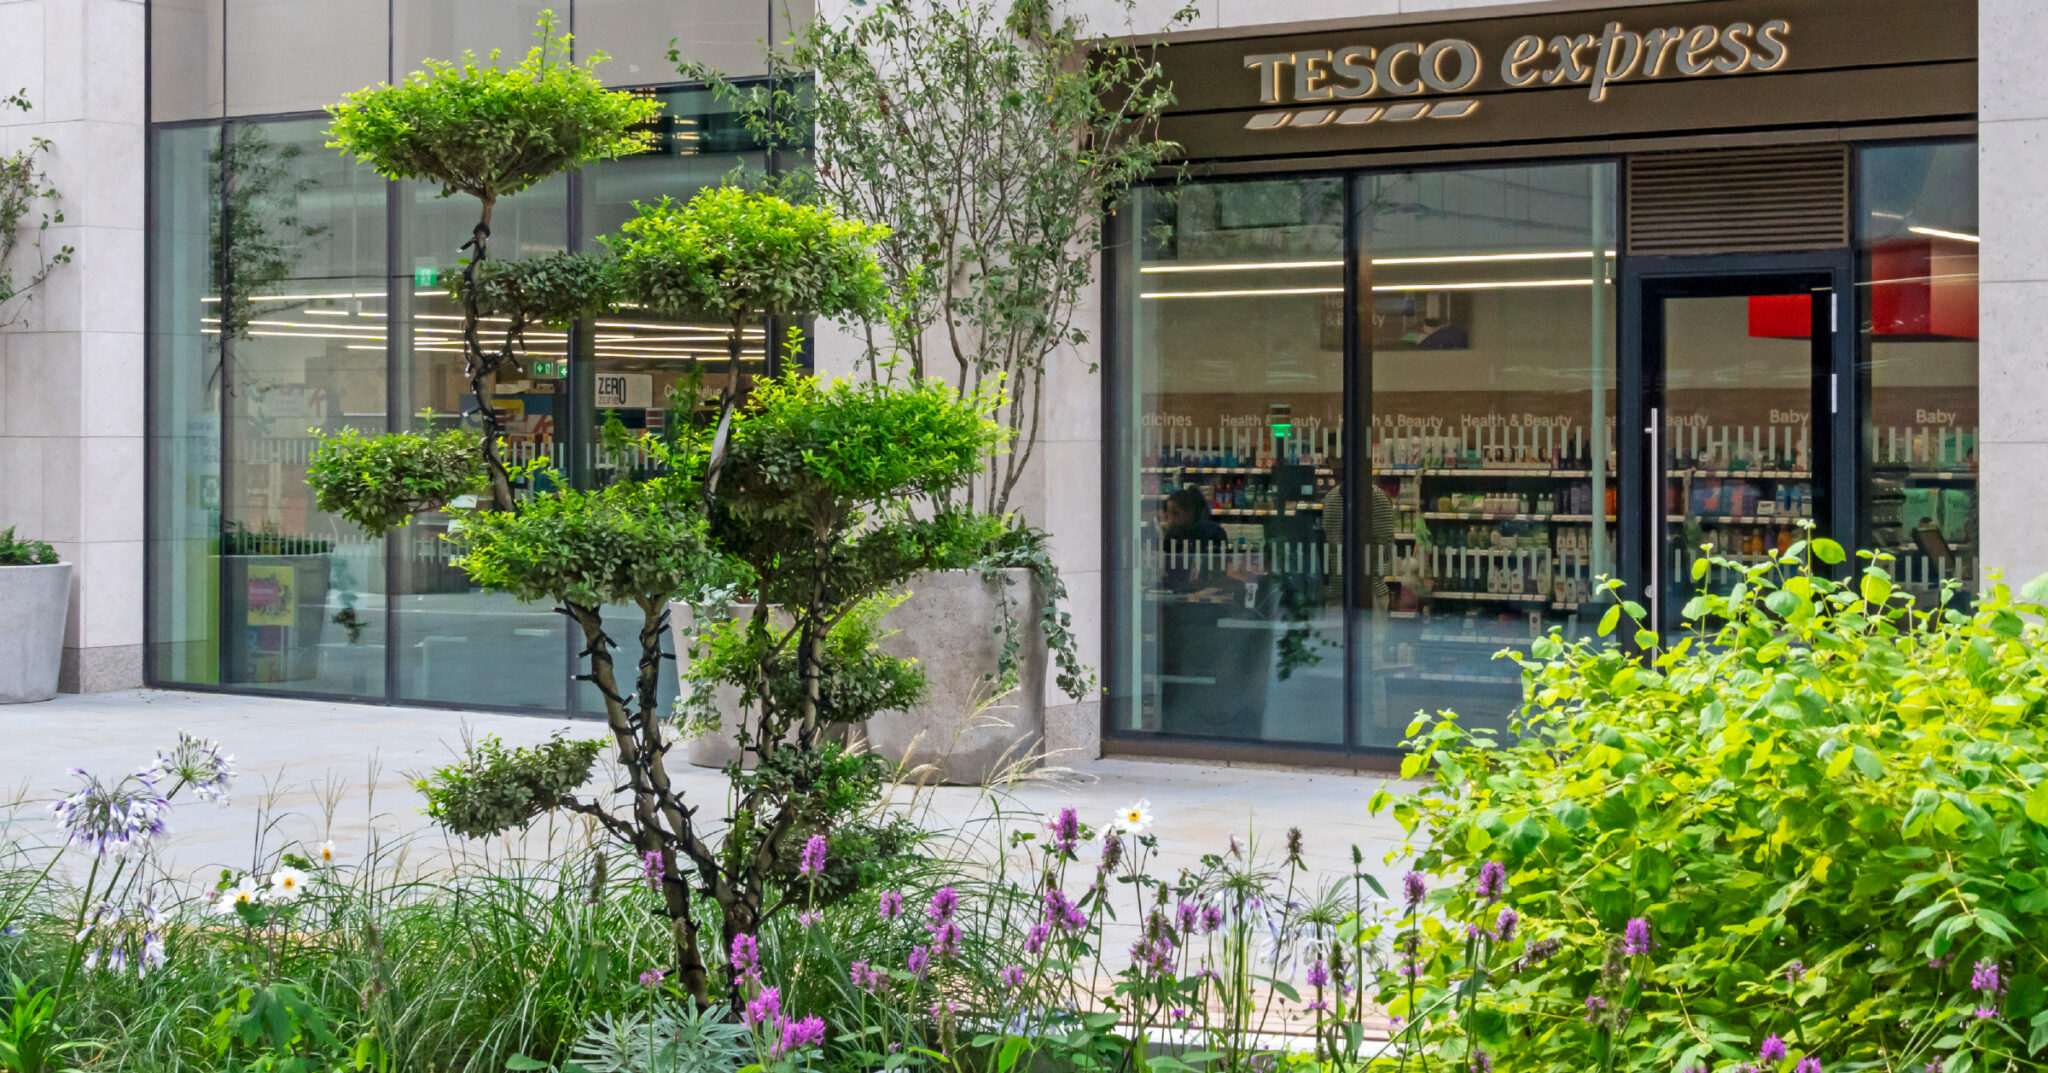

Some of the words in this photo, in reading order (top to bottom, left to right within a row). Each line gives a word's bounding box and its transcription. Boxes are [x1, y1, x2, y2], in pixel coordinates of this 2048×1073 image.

[1244, 38, 1482, 103] TESCO
[1501, 20, 1790, 103] express
[1141, 412, 1192, 427] dicines
[1220, 414, 1262, 427] Health
[1290, 414, 1321, 431] auty
[1385, 414, 1393, 427] &
[1398, 414, 1443, 429] Beauty
[1461, 414, 1505, 427] Health
[1510, 414, 1519, 427] &
[1524, 413, 1571, 430] Beauty
[1666, 413, 1708, 430] eauty
[1770, 409, 1809, 427] Baby
[1916, 409, 1956, 427] Baby
